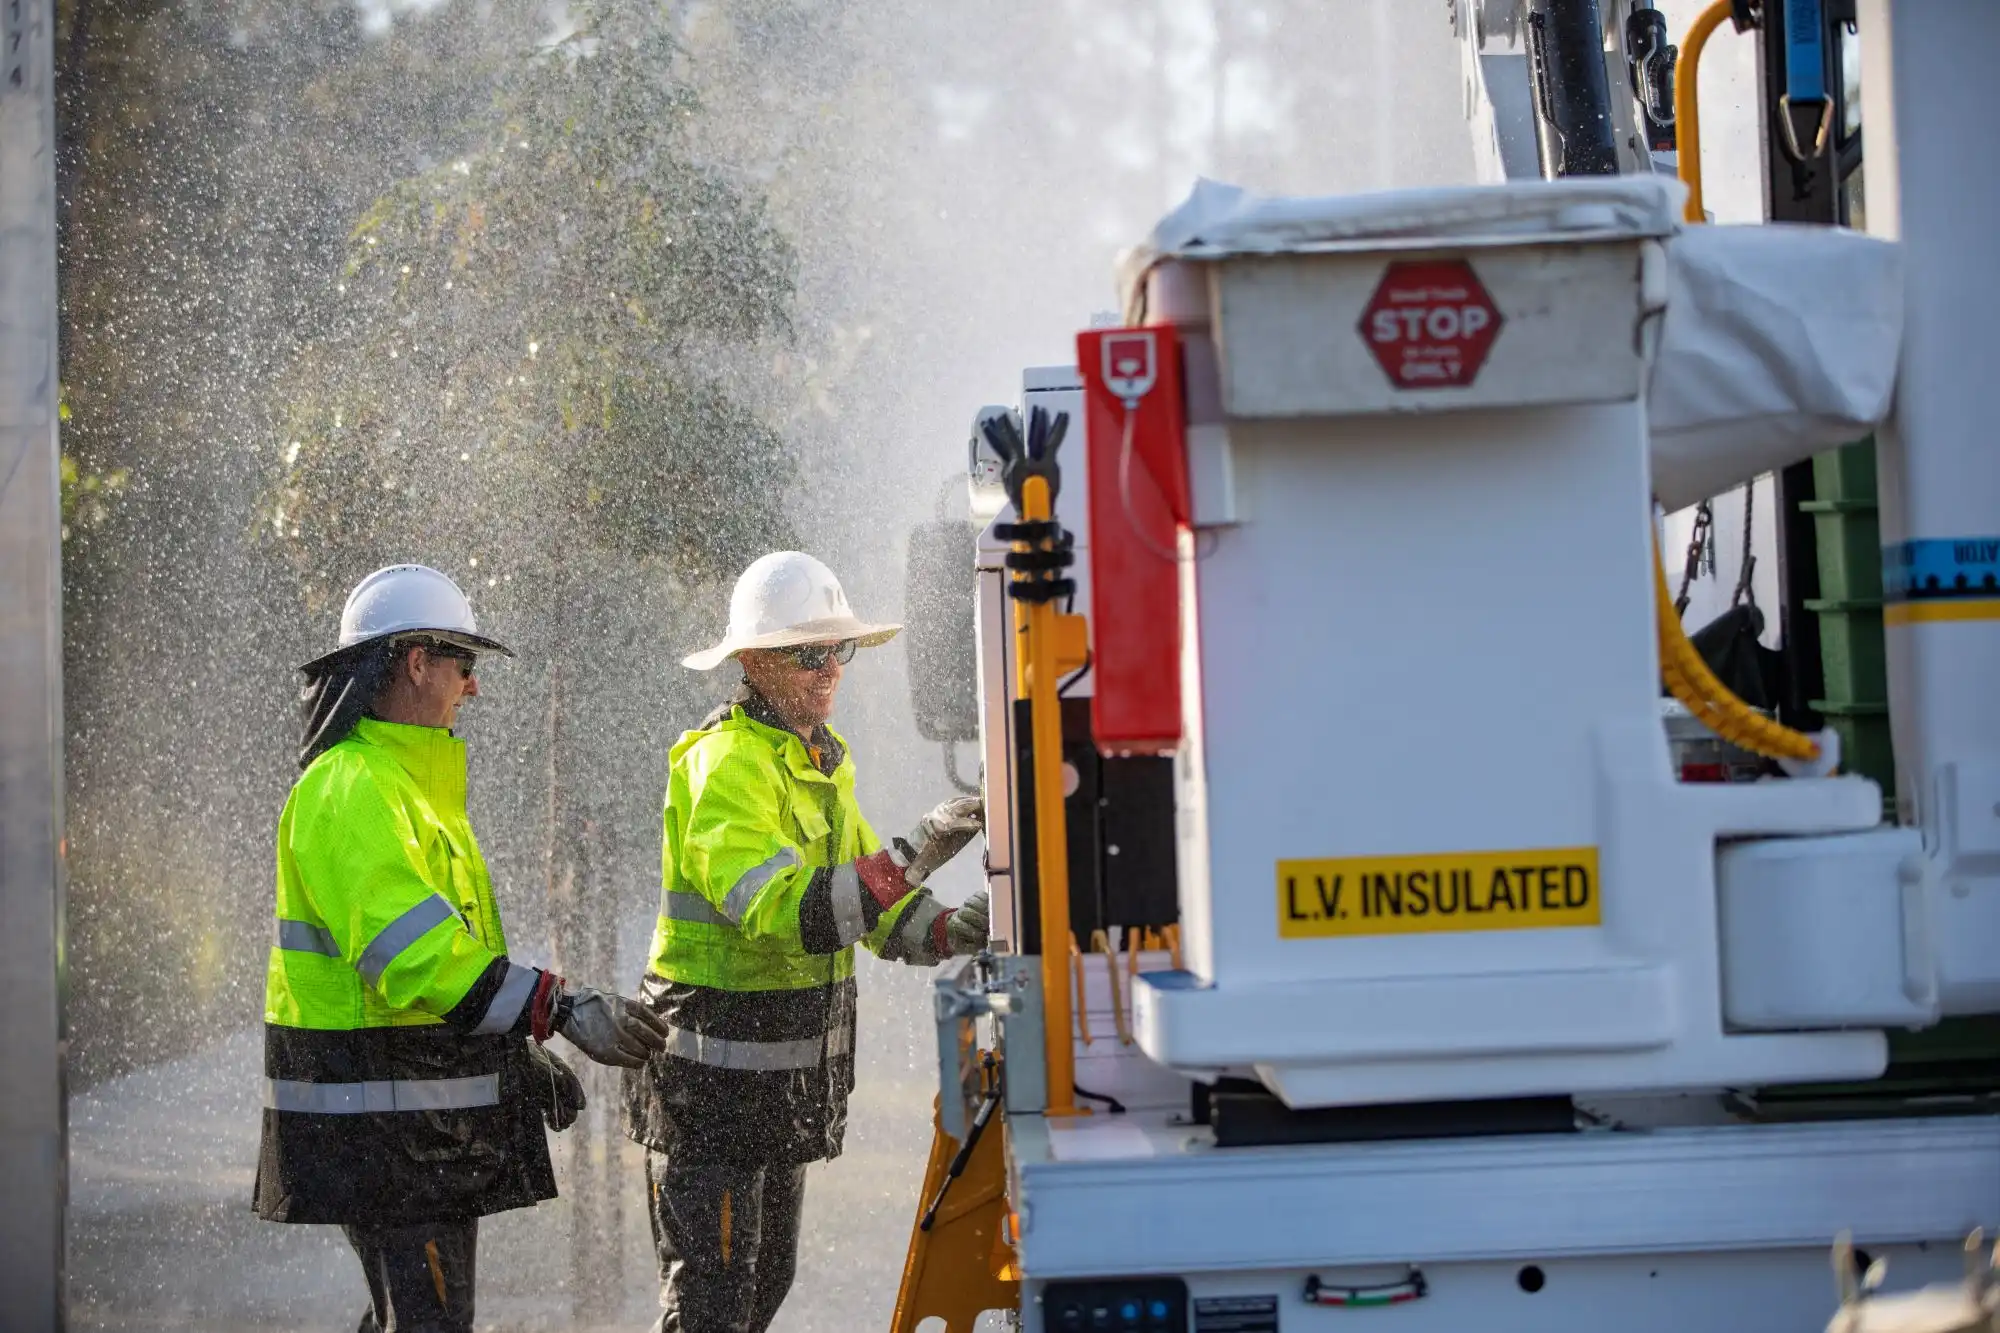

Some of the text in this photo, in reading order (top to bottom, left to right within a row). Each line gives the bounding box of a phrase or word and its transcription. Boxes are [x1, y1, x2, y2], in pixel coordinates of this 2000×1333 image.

[1372, 305, 1489, 342] STOP
[1286, 864, 1590, 921] L.V. INSULATED
